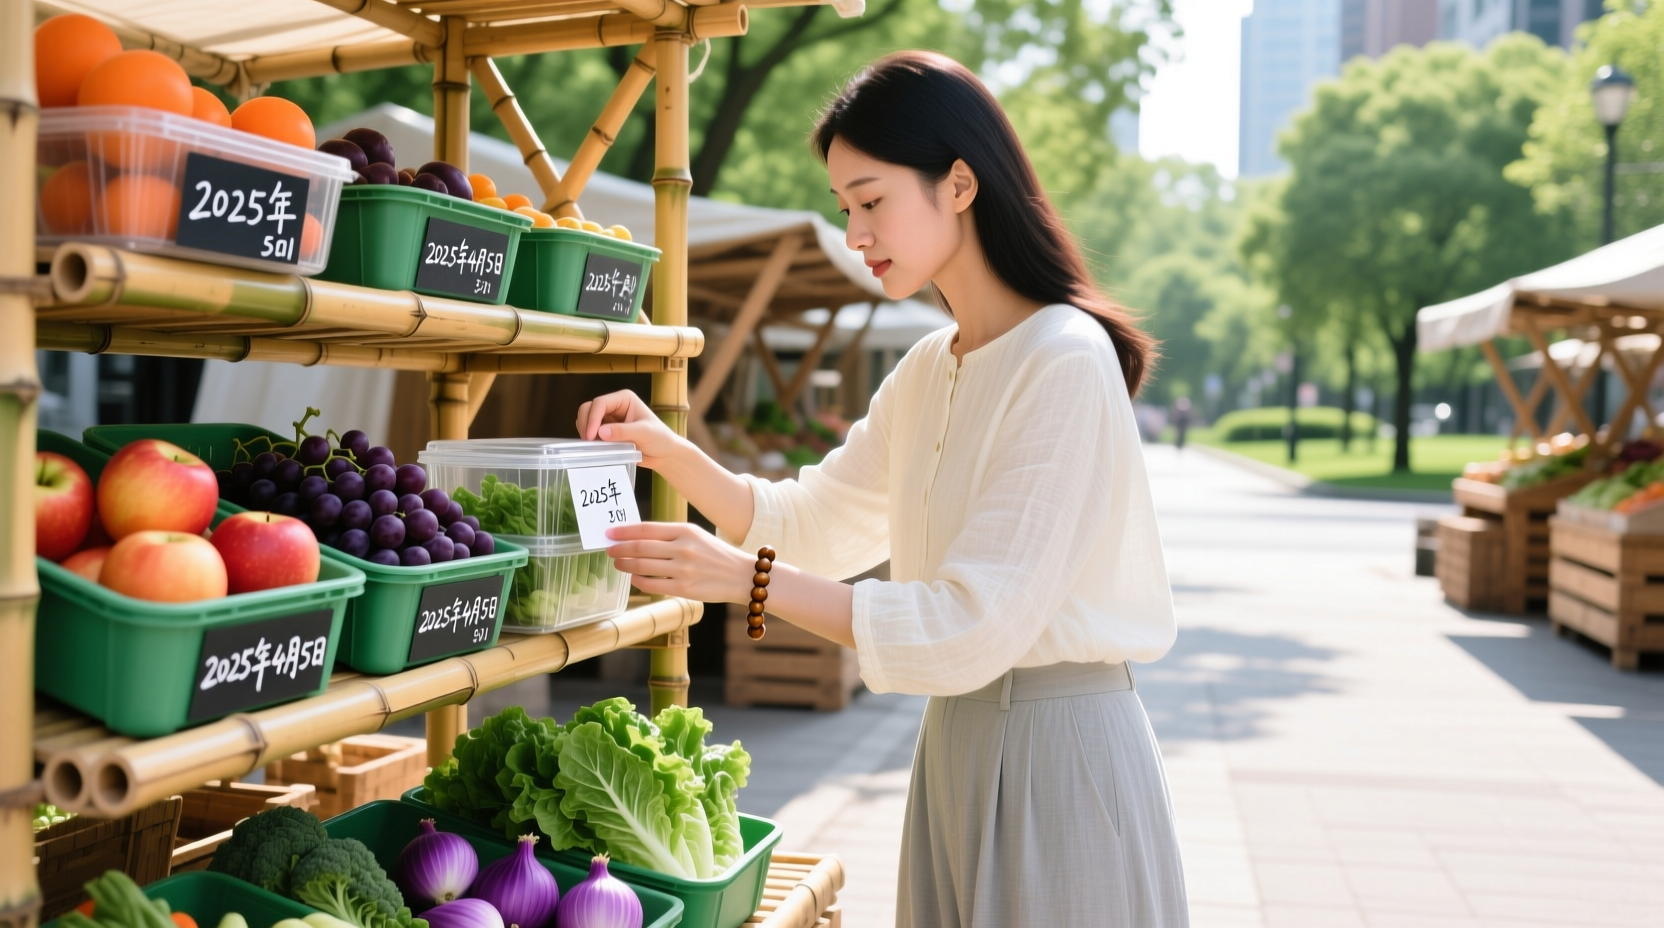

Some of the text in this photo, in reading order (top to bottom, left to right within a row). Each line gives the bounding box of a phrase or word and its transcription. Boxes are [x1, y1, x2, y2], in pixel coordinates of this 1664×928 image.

[188, 180, 297, 235] 2025年
[425, 238, 504, 276] 2025年4月5日
[580, 478, 622, 509] 2025年
[418, 595, 498, 634] 2025年4月5日
[200, 635, 327, 693] 2025年4月5日
